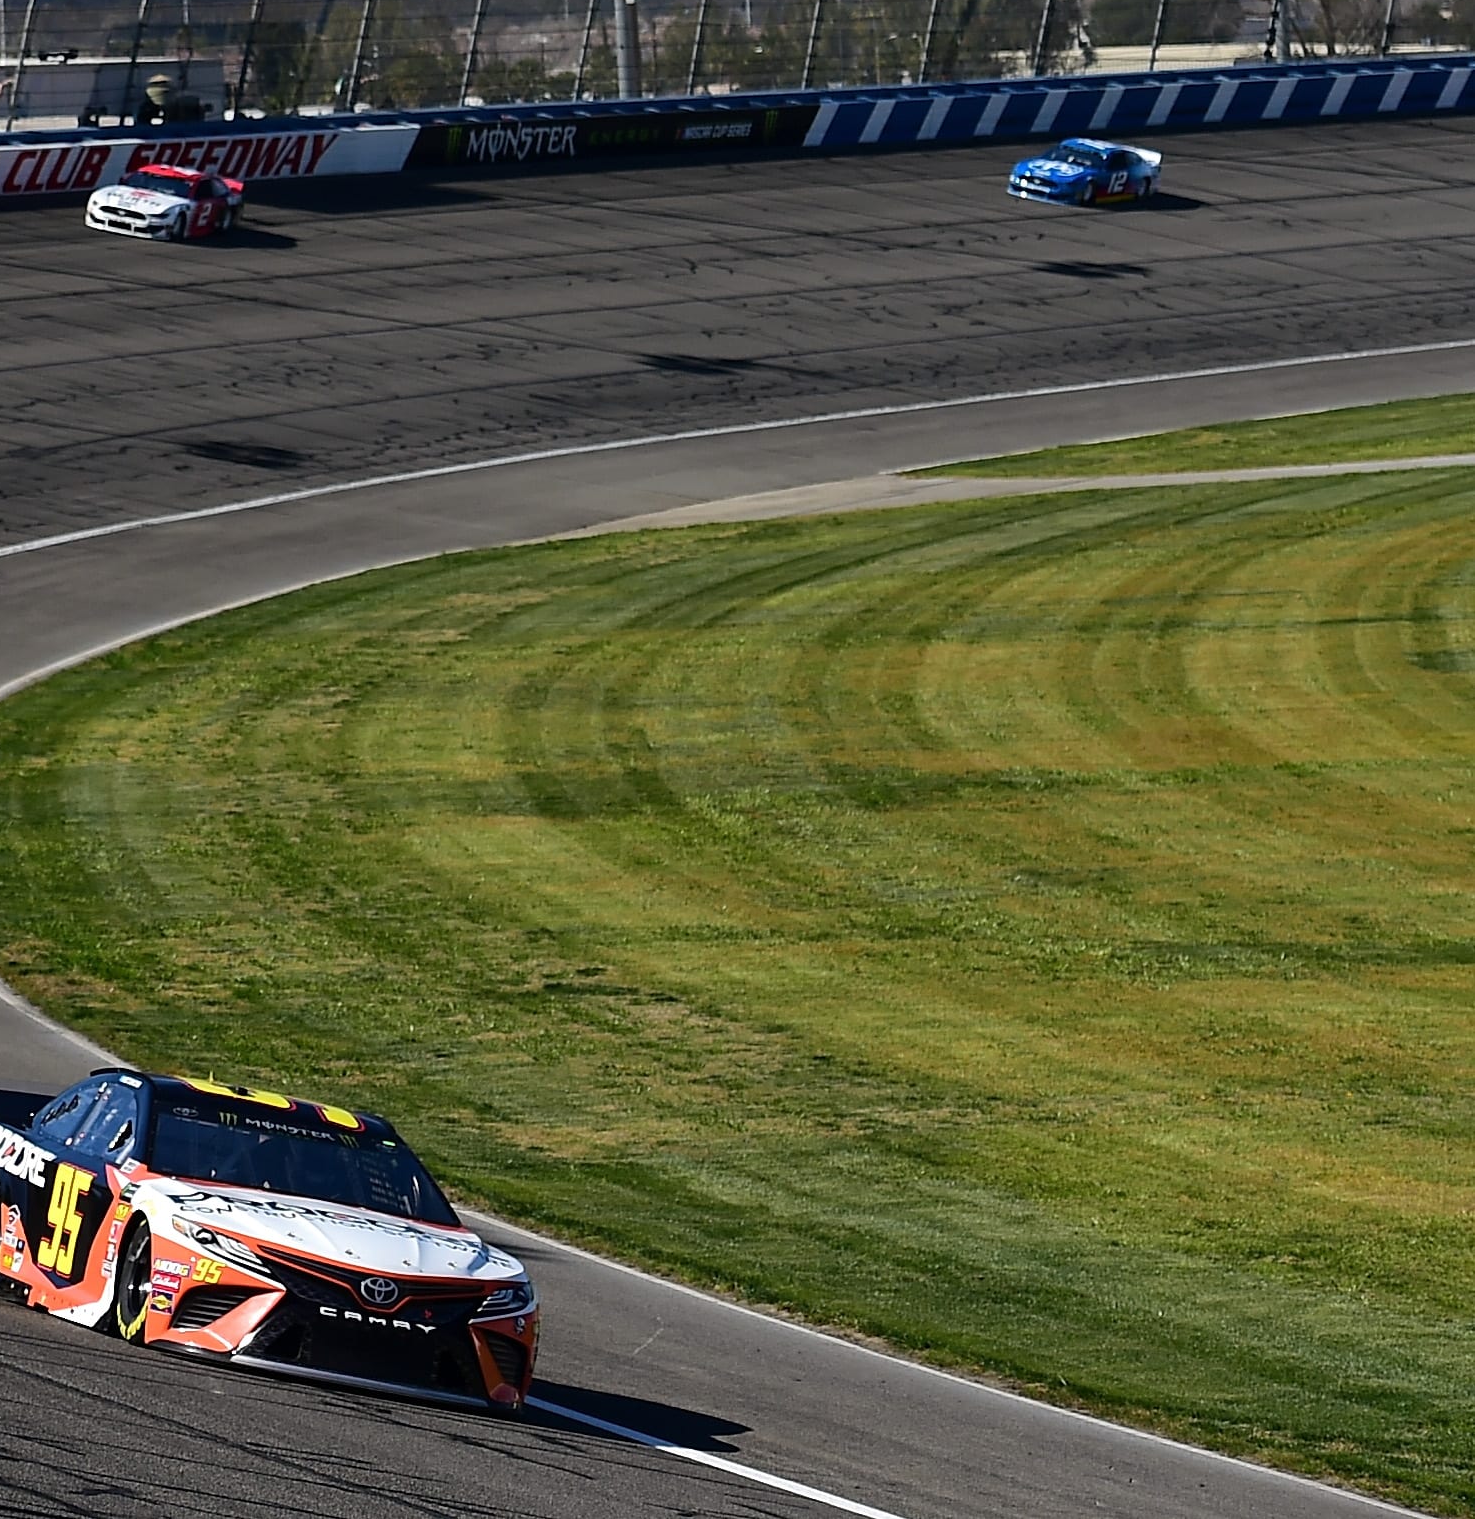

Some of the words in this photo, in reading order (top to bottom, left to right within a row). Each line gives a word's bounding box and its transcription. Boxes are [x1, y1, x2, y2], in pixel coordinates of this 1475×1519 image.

[466, 121, 577, 162] MONSTER
[2, 145, 112, 194] CLUB
[126, 134, 339, 179] SPEEDWAY
[1107, 171, 1128, 194] 12
[197, 202, 213, 226] 2
[245, 1117, 336, 1142] MONSTER
[38, 1162, 96, 1277] 95
[192, 1258, 227, 1284] 95
[319, 1305, 437, 1334] CAMRY
